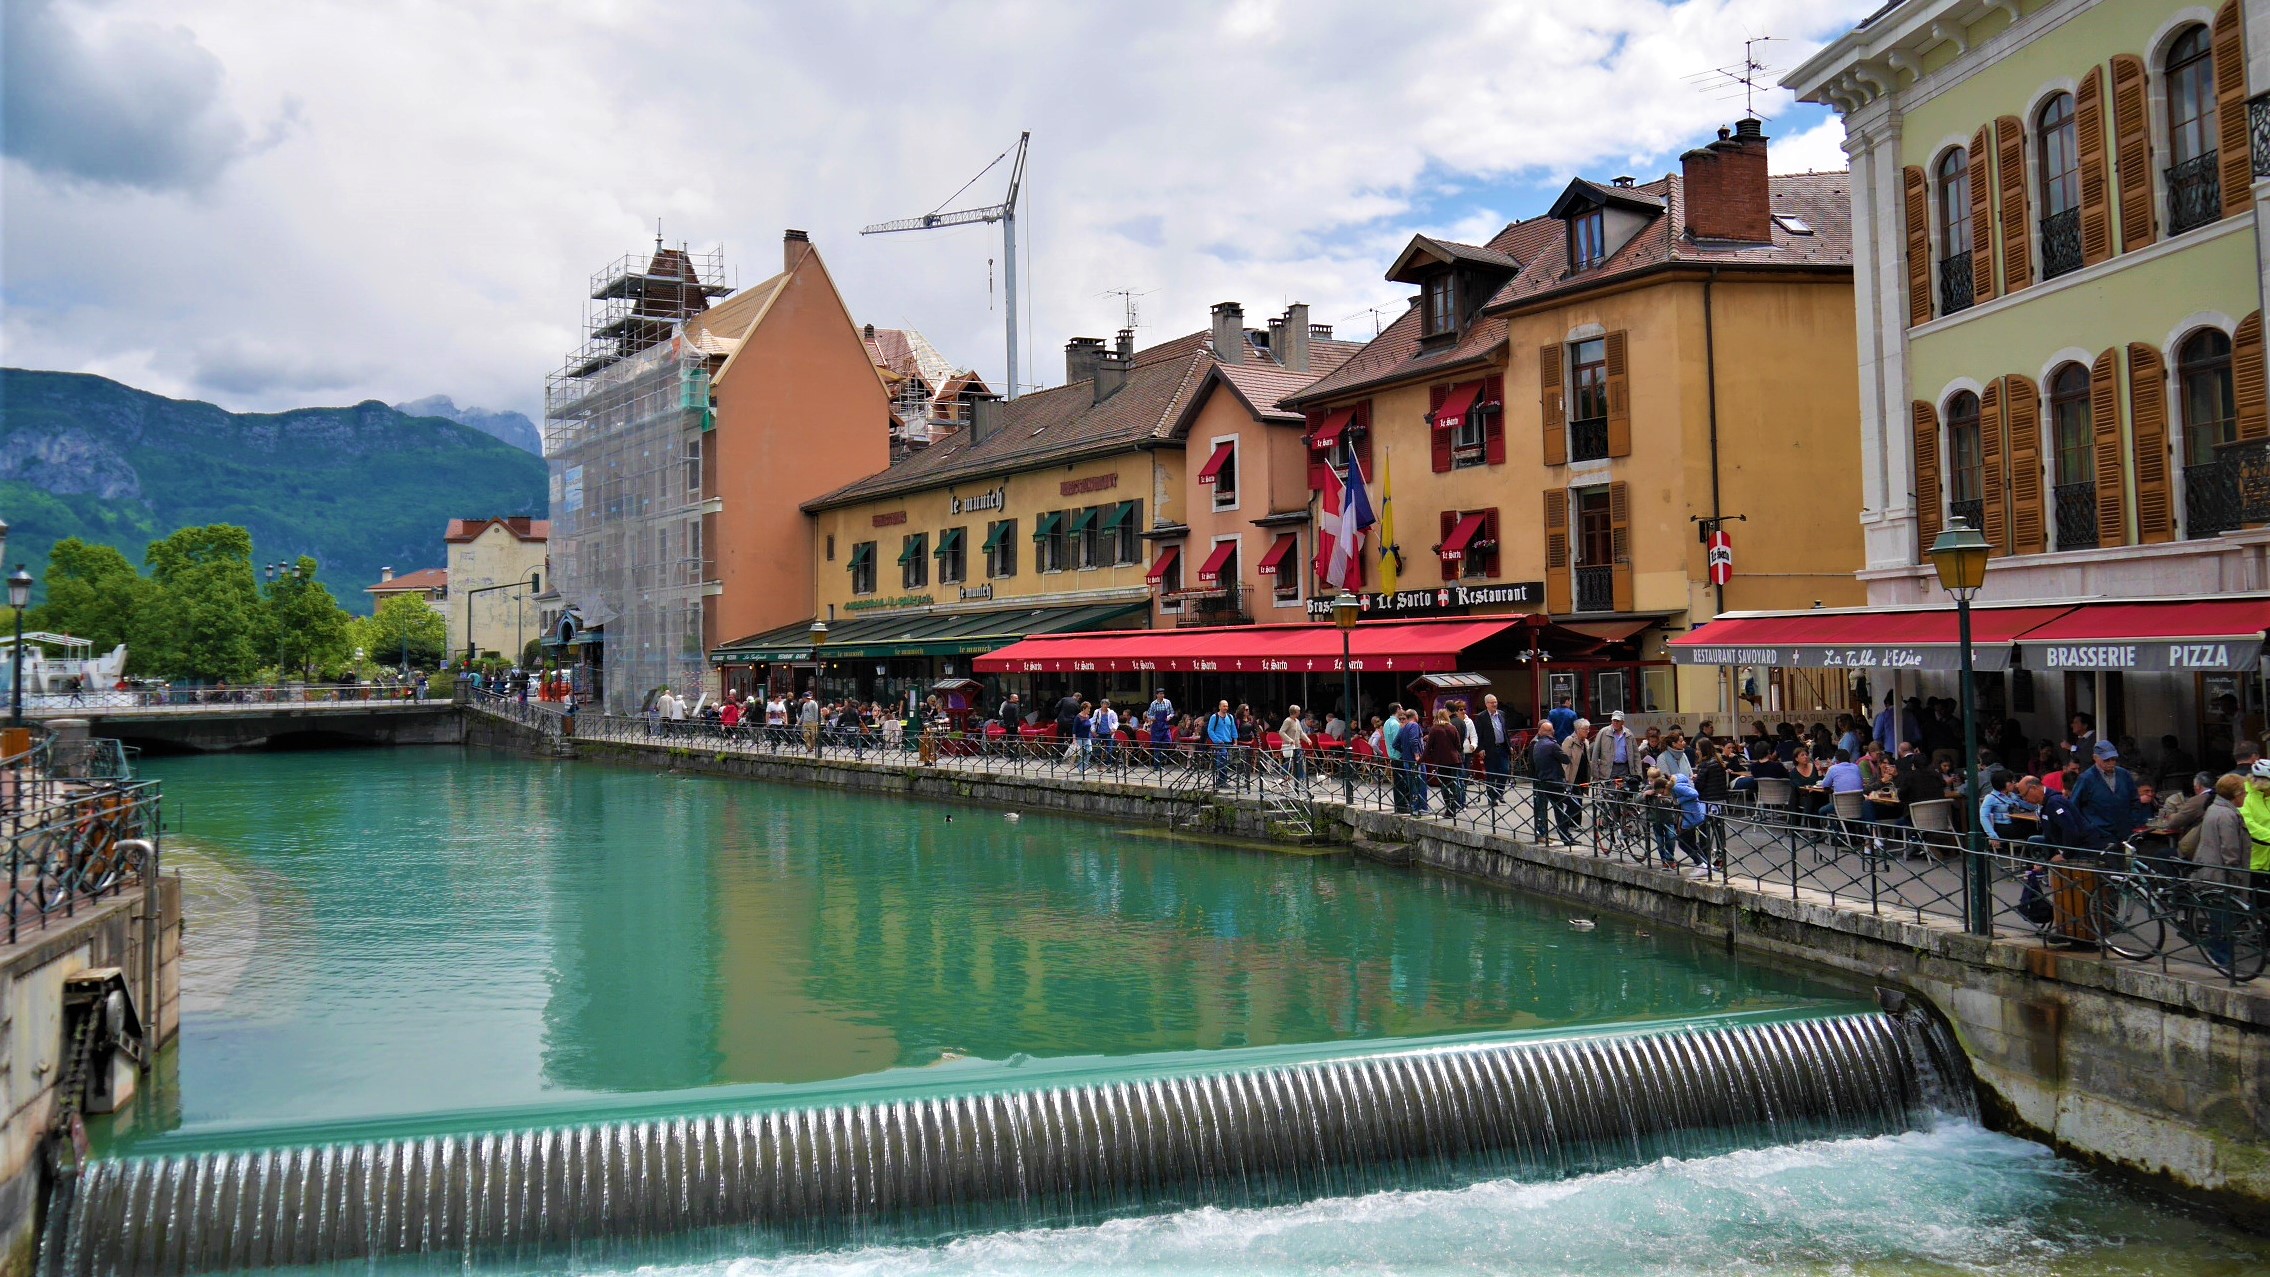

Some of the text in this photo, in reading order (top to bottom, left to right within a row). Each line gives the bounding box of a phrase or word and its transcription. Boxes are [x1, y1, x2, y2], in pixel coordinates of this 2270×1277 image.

[951, 486, 1004, 515] le munich
[966, 583, 992, 600] munich
[1377, 593, 1392, 609] Le
[1396, 591, 1431, 610] Sarto
[1456, 585, 1527, 605] Restaurant
[1693, 648, 1736, 663] RESTAURANT
[1738, 648, 1777, 664] SAVOYARD
[1824, 649, 1922, 667] La Table d'Elise
[2046, 644, 2229, 667] BRASSERIE PIZZA
[1074, 661, 1080, 670] Le
[1132, 660, 1139, 670] Le
[1192, 659, 1217, 670] Le Sarto
[1261, 658, 1288, 670] Le Sarto
[1344, 659, 1364, 670] arto
